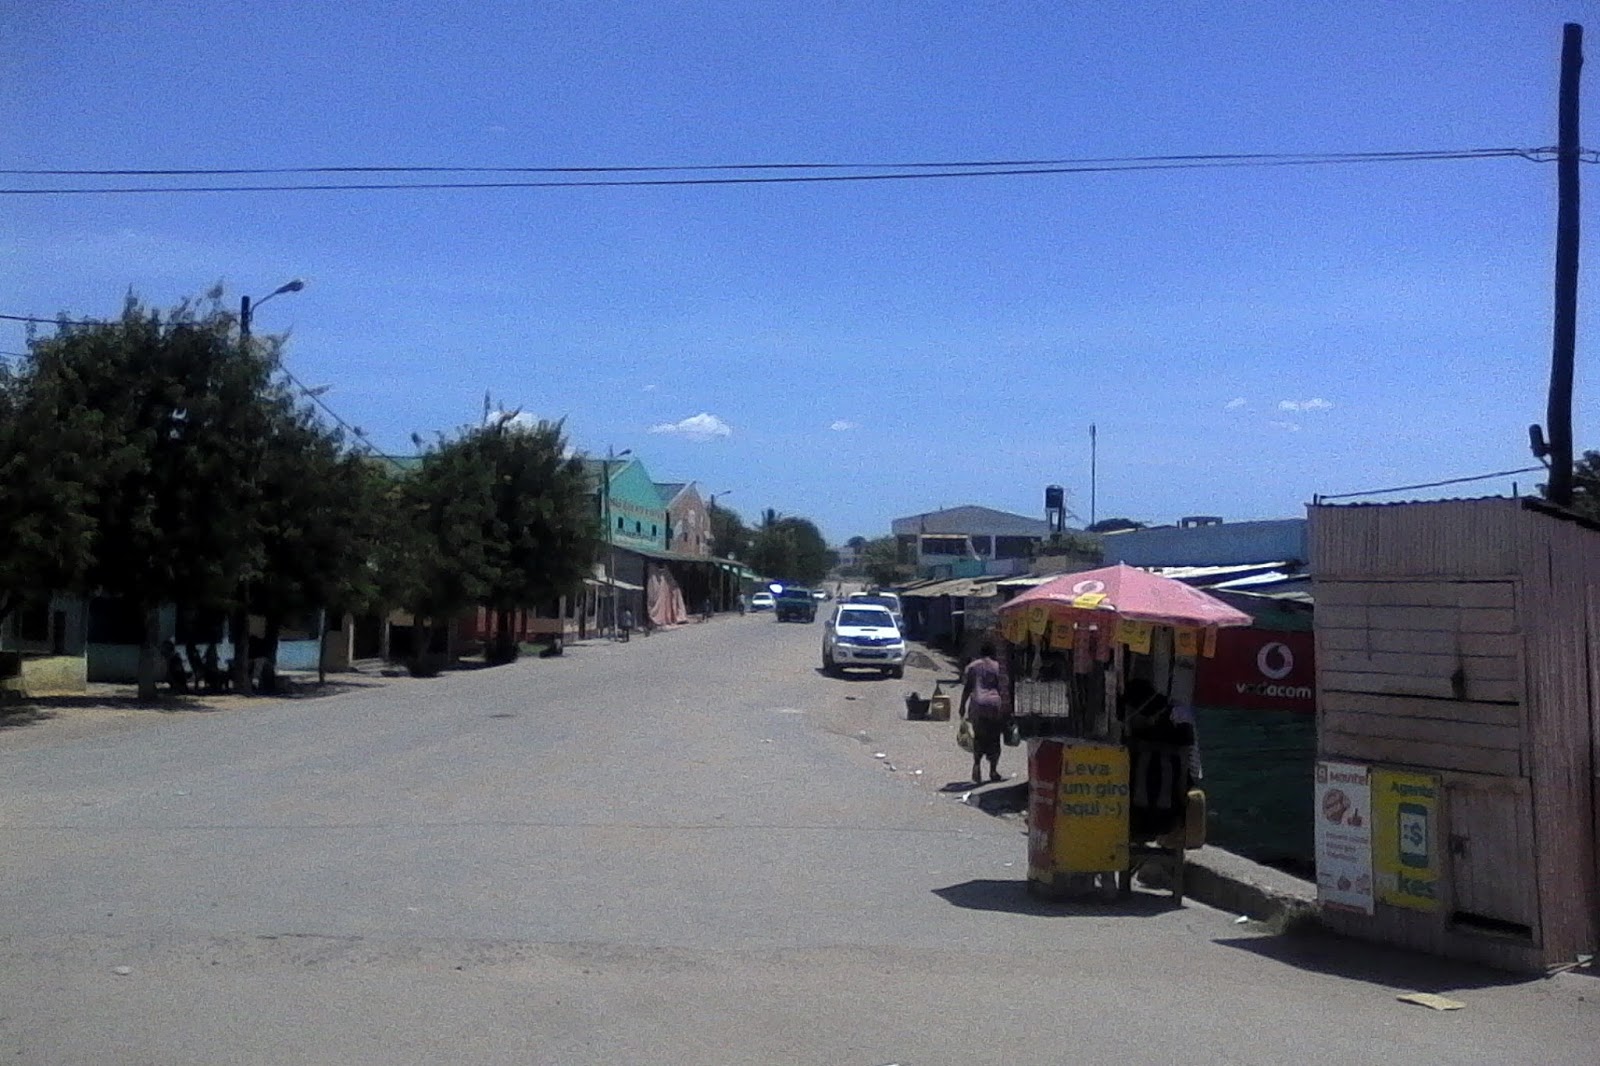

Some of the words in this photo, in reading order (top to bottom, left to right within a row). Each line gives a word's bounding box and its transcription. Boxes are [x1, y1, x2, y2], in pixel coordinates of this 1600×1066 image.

[1064, 761, 1111, 775] Leva
[1063, 783, 1091, 795] um
[1096, 780, 1129, 797] giro
[1063, 800, 1100, 817] aqui
